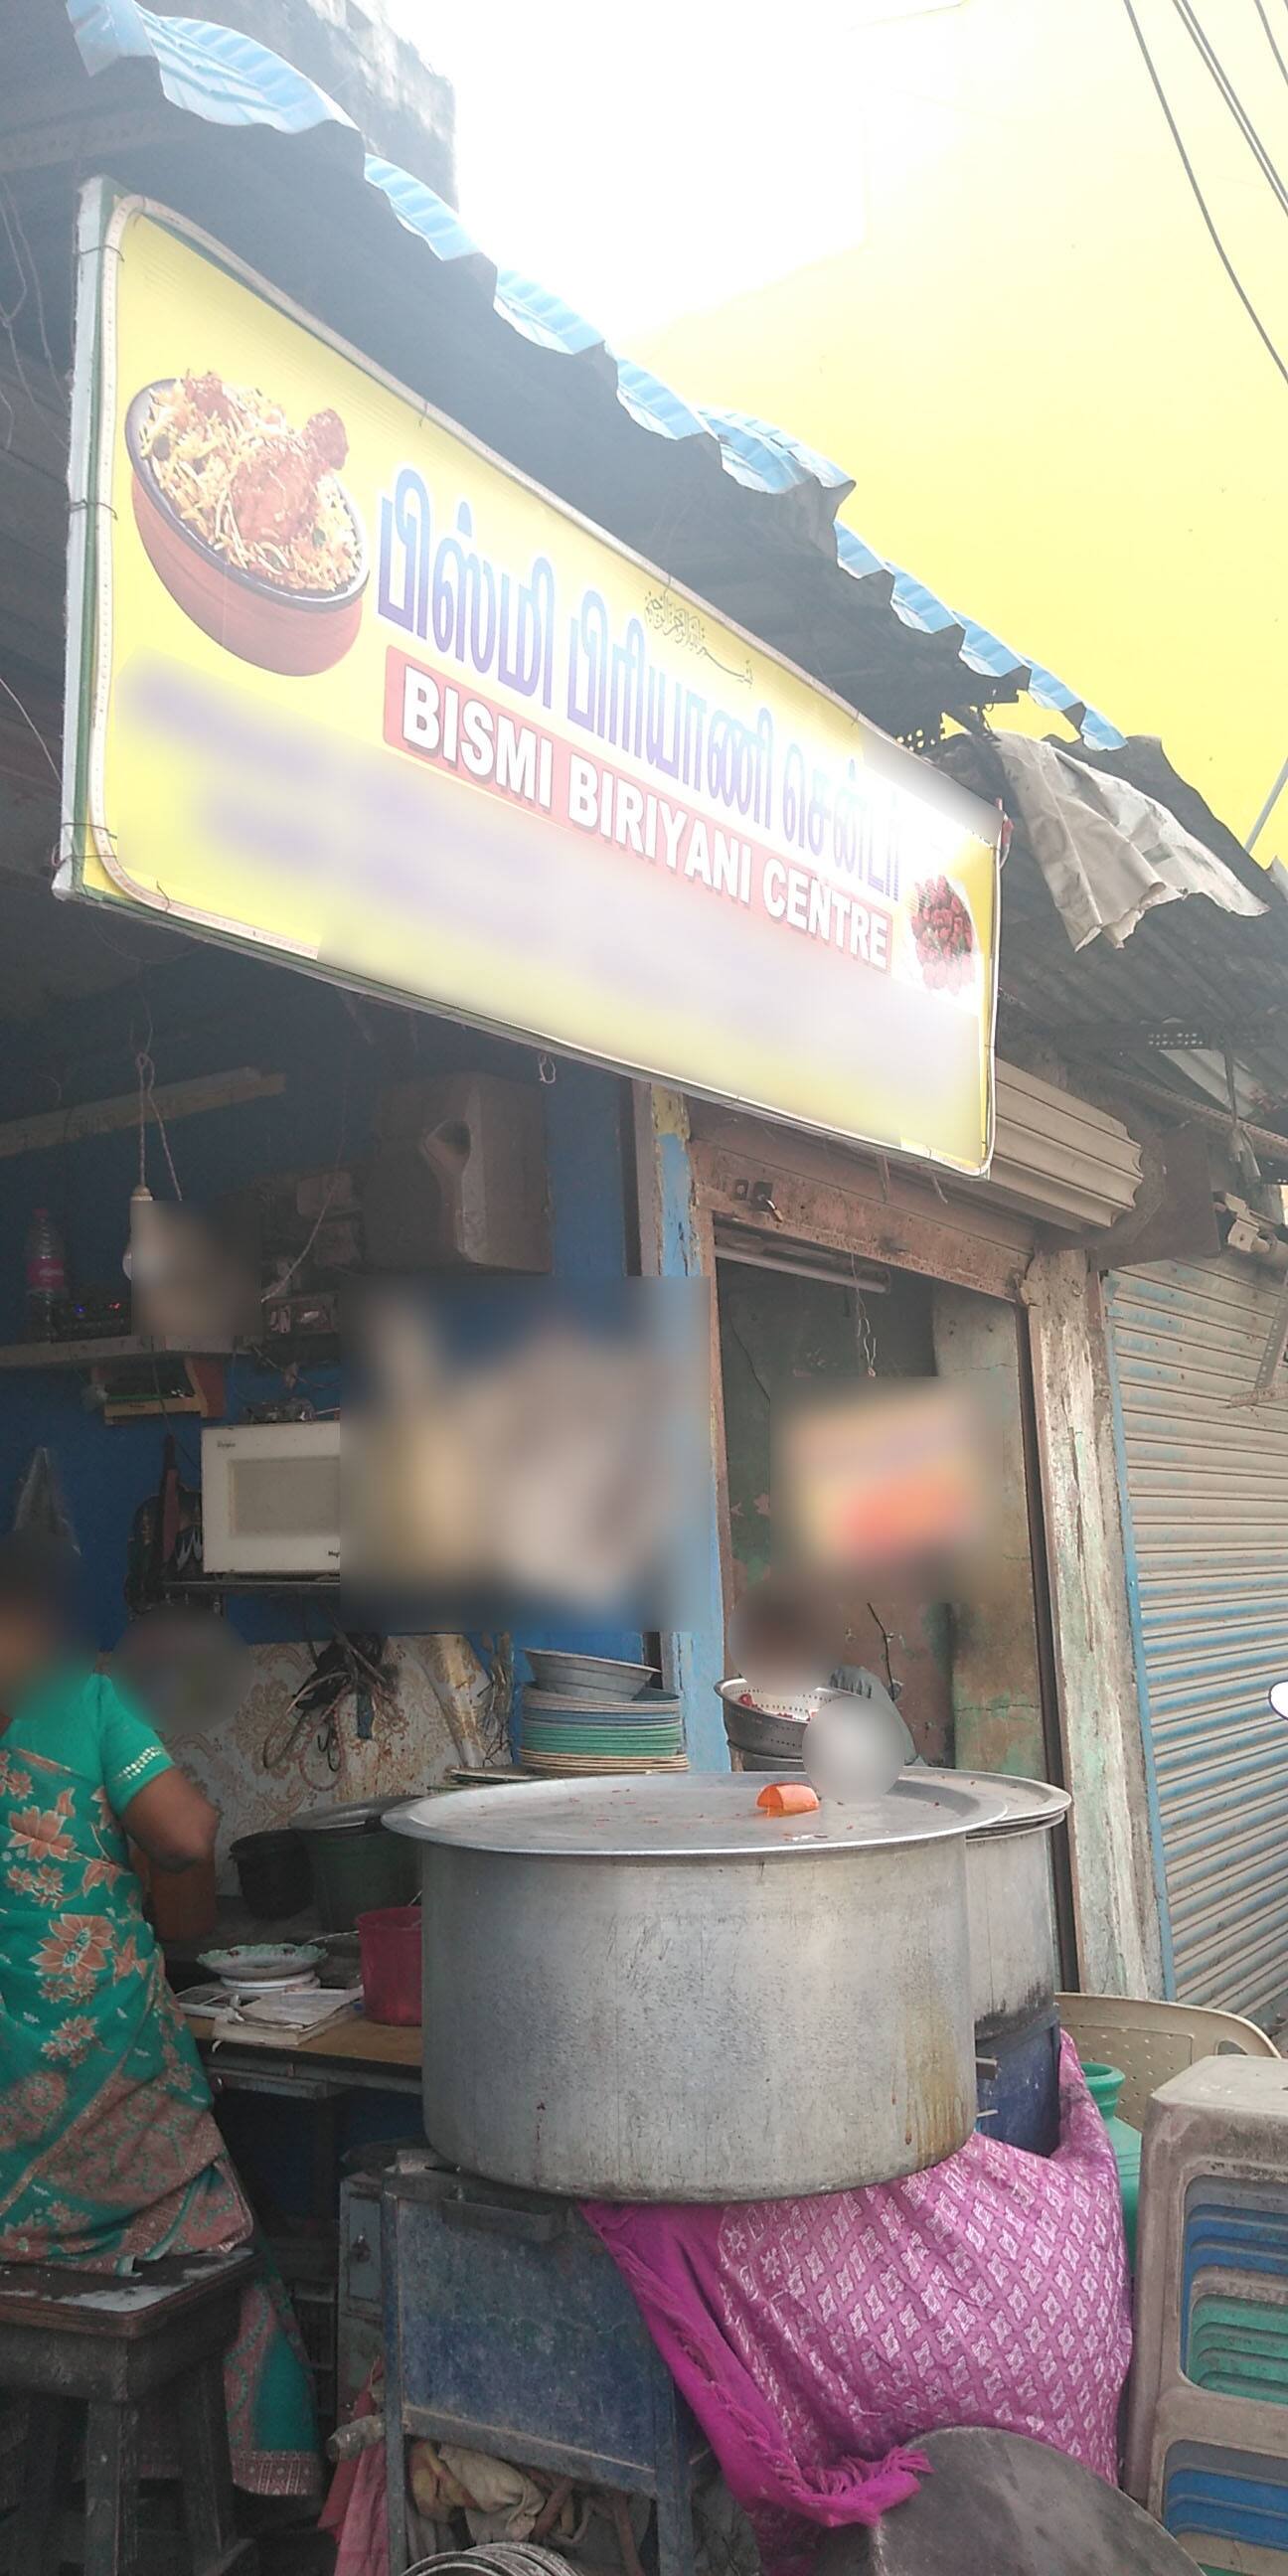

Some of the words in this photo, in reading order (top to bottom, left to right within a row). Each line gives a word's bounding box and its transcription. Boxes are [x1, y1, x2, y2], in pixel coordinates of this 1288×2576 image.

[378, 469, 555, 709] பிஸ்மி
[567, 590, 772, 829] பிரியாணி
[402, 664, 554, 808] BISMI
[567, 753, 752, 903] BIRIYANI
[763, 858, 887, 970] CENTRE
